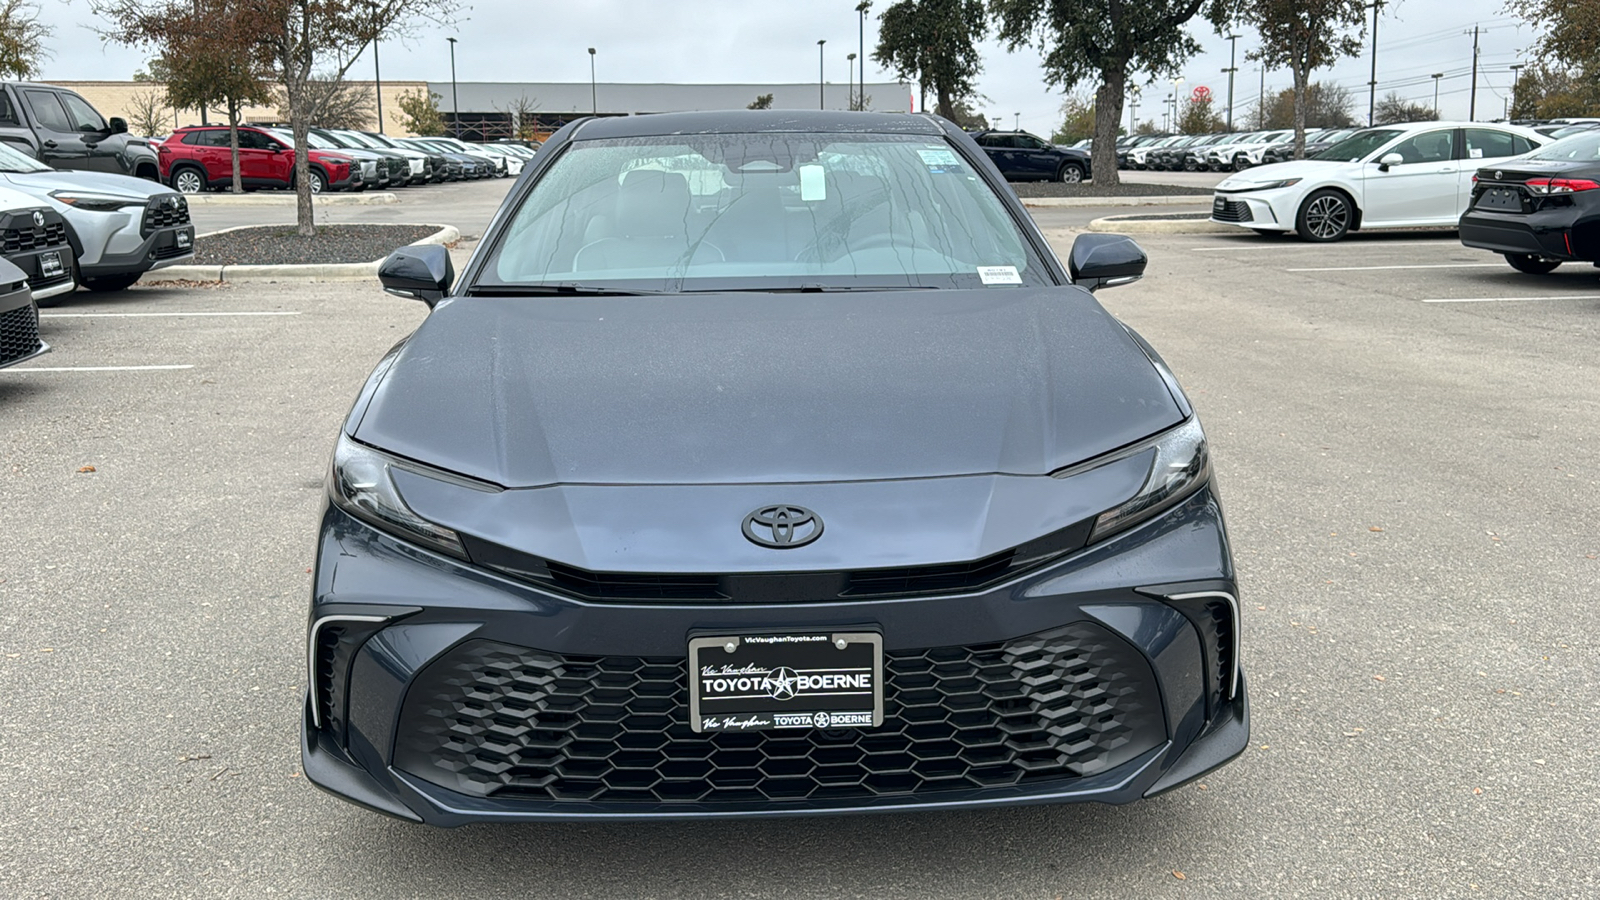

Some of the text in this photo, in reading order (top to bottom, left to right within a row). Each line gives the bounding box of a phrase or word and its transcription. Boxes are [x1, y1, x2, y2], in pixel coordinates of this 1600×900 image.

[744, 635, 828, 644] VicVaughanToyota.com
[701, 662, 767, 677] Vic Vaughan
[702, 677, 772, 693] TOYOTA
[797, 674, 872, 690] BOERNE
[703, 715, 872, 730] Vic Vaughan TOYOTA BOERNE
